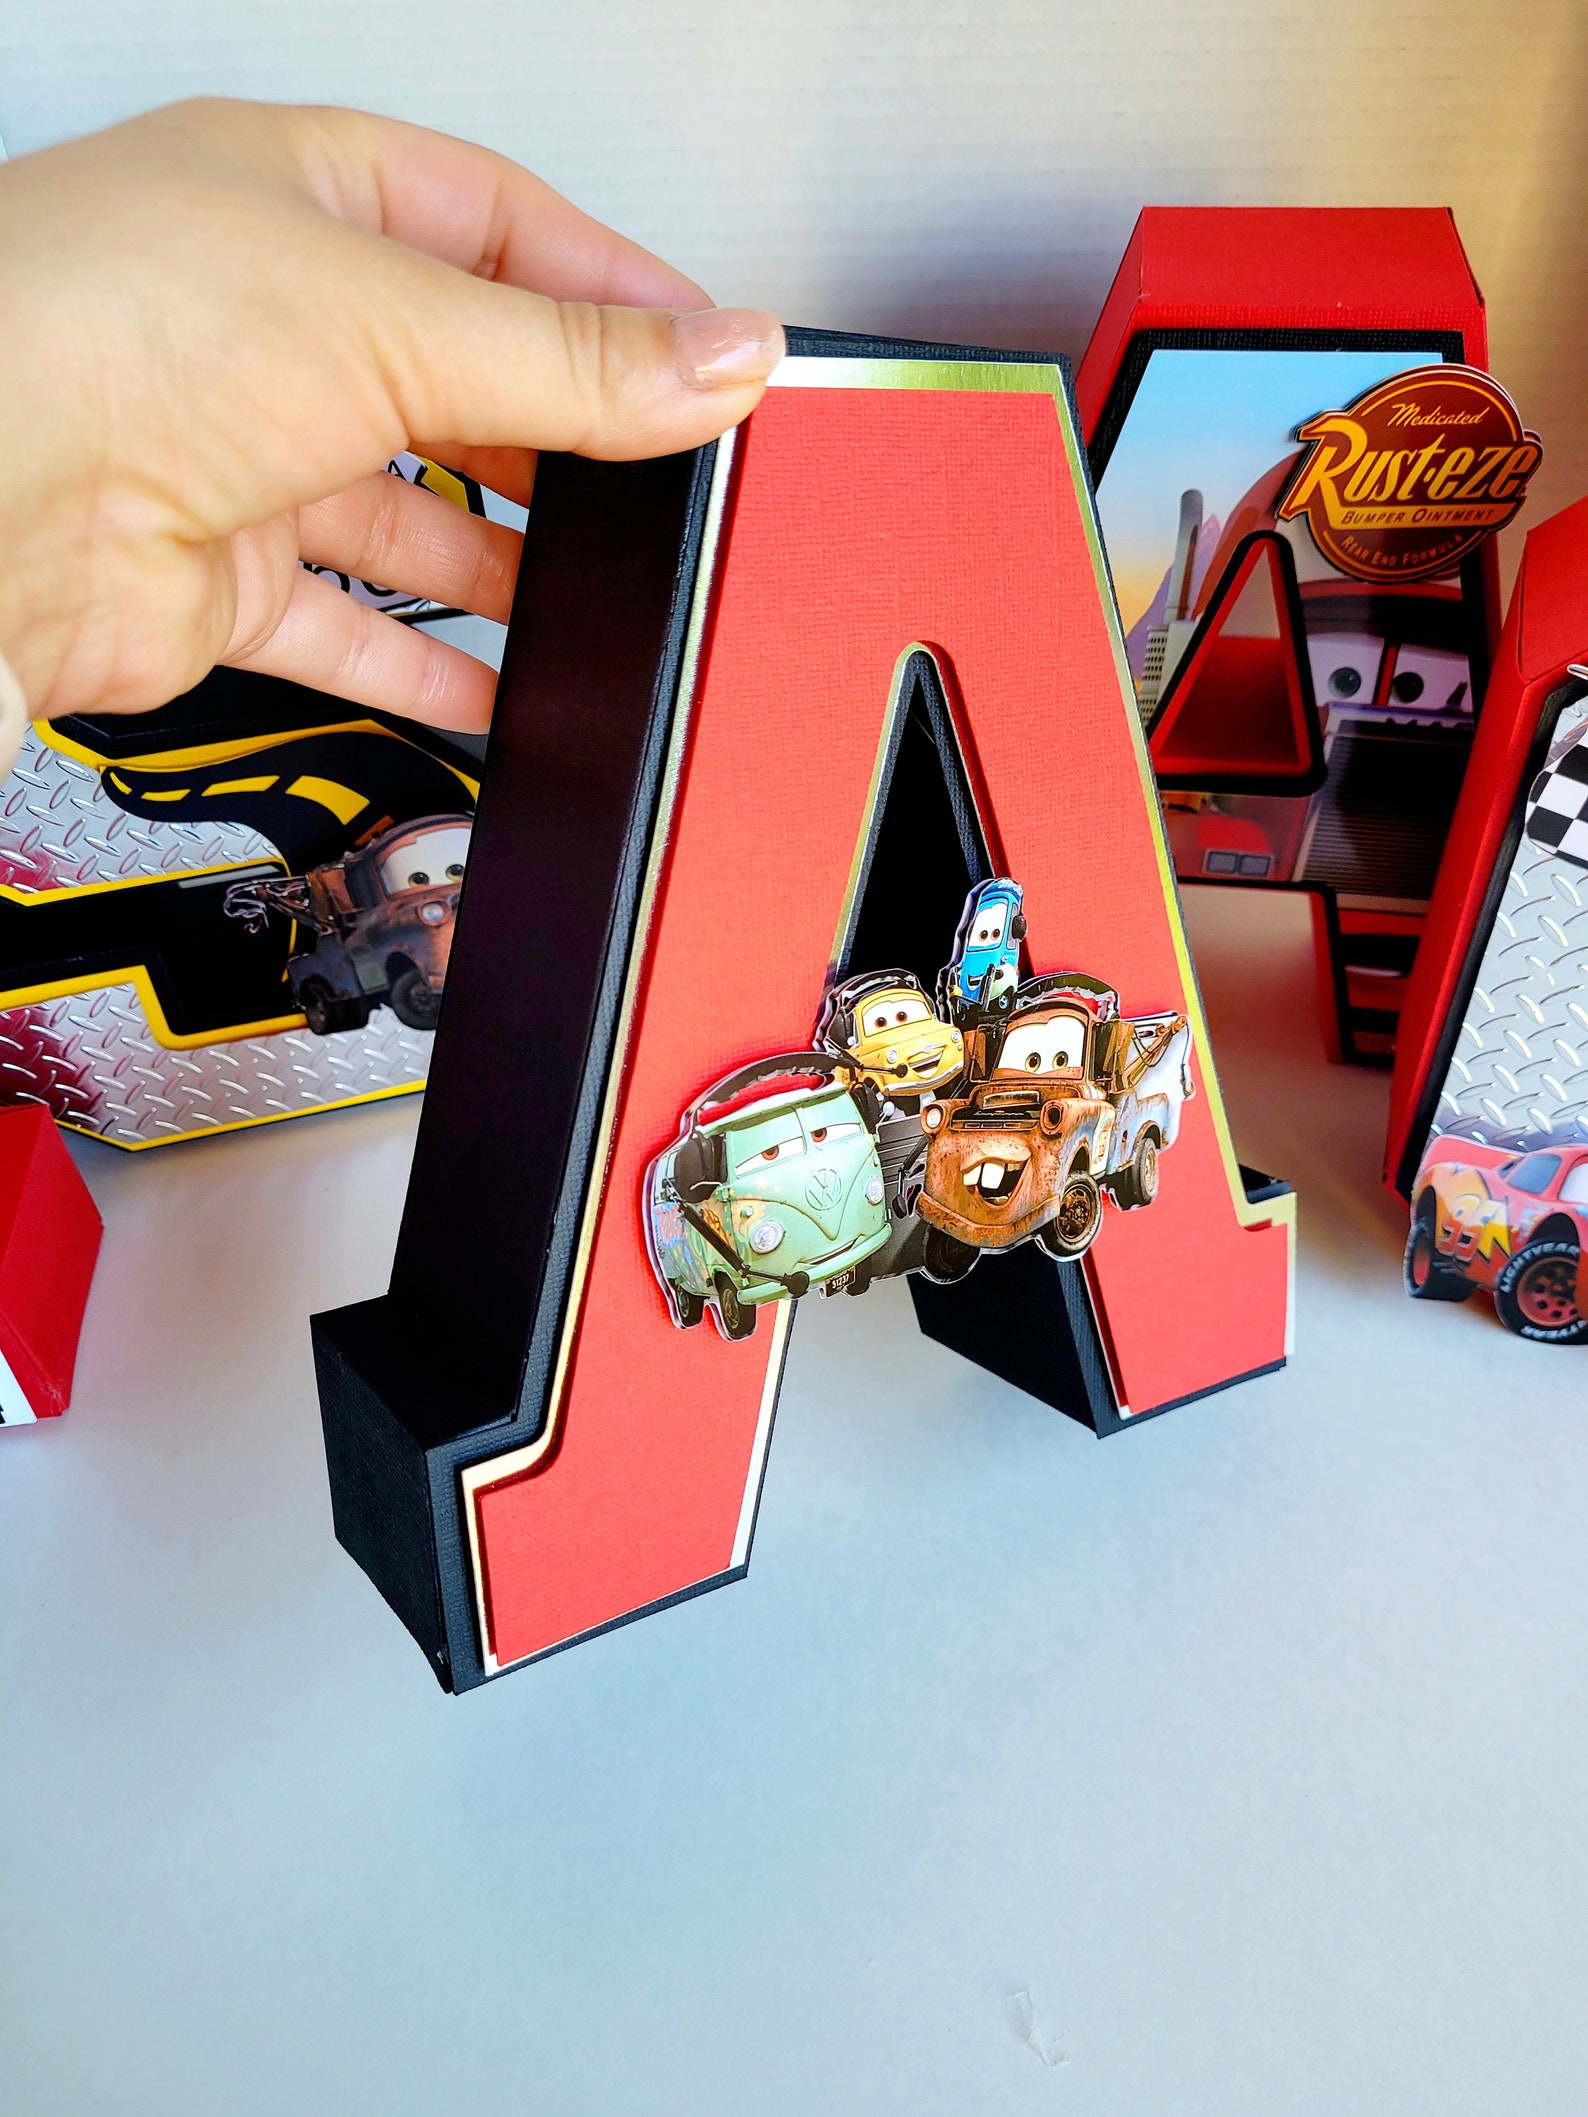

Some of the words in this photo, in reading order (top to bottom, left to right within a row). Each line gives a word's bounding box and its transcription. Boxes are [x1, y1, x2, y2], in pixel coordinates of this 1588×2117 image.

[1387, 403, 1490, 428] Medicated
[1341, 511, 1405, 525] BUMPER
[1411, 508, 1495, 523] OINTMENT
[1341, 535, 1368, 561] REAR
[1371, 552, 1396, 567] END
[1402, 533, 1463, 565] FORMULA
